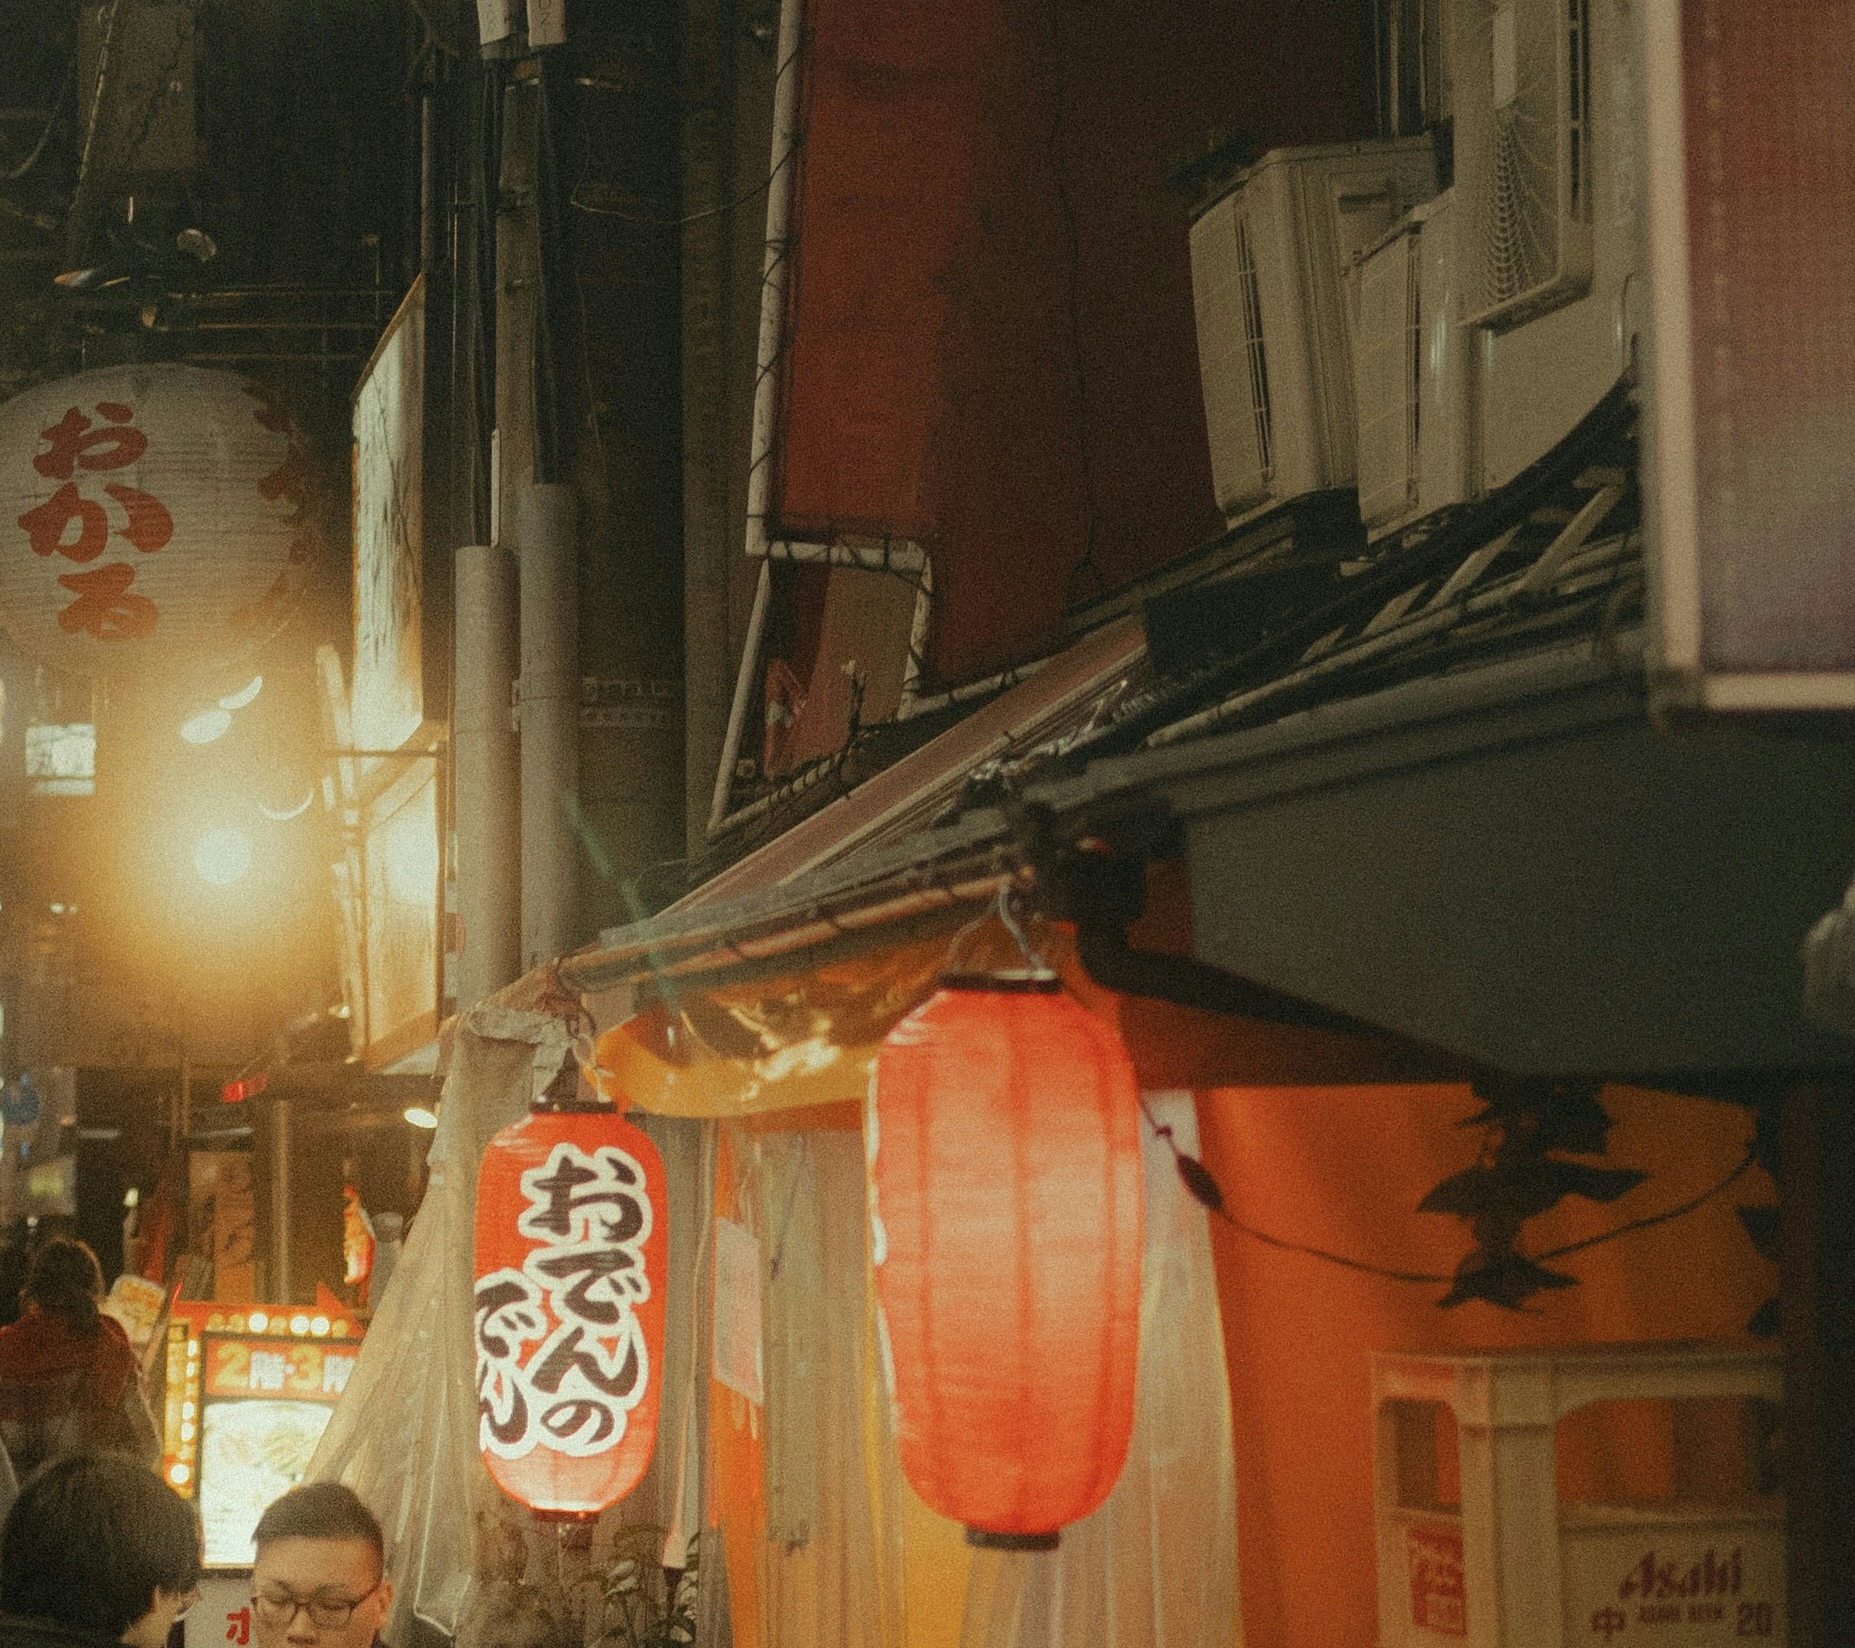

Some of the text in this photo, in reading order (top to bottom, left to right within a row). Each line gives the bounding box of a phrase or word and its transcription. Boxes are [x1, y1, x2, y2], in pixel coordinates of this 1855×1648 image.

[18, 402, 174, 642] おかる
[527, 1155, 645, 1446] おでんの
[1618, 1547, 1743, 1601] Asahi
[1591, 1606, 1626, 1643] 中
[1736, 1602, 1773, 1637] 20
